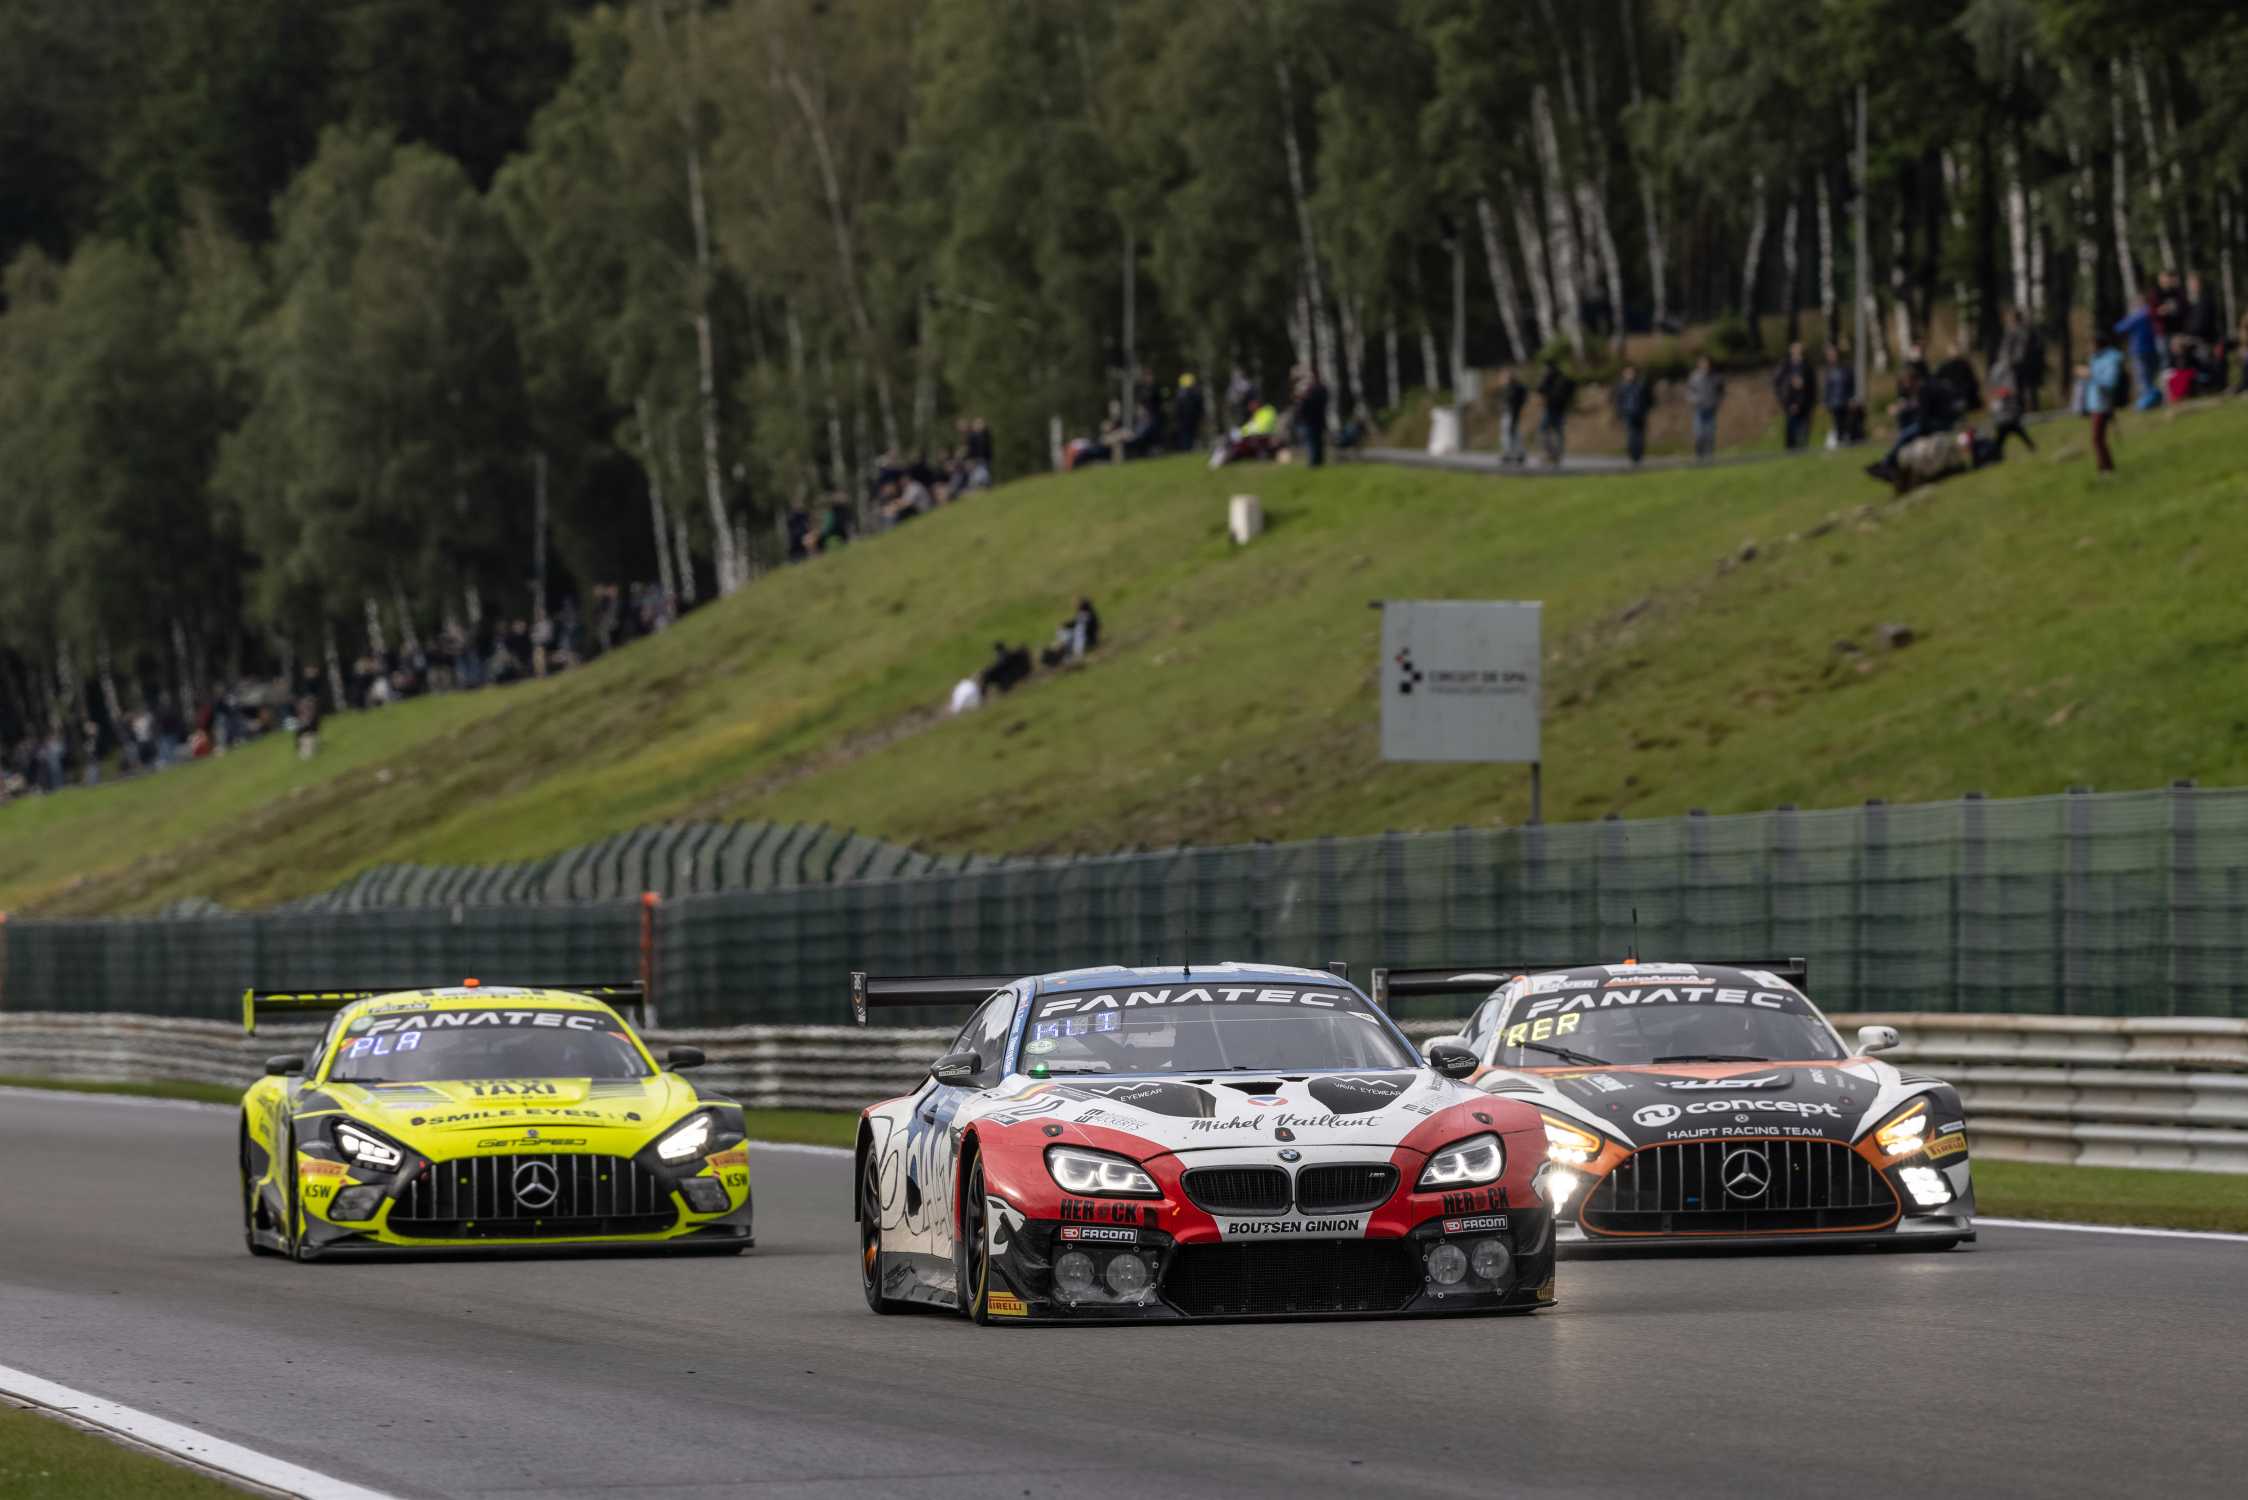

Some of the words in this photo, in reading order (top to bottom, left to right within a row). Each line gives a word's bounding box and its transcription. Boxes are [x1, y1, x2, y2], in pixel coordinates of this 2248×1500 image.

[1039, 988, 1343, 1018] FANATEC
[1526, 987, 1786, 1019] FANATEC
[366, 1011, 596, 1037] FANATEC
[349, 1031, 422, 1059] PLA
[1120, 1087, 1163, 1103] EYEWEAR
[428, 1108, 515, 1125] SMILE
[526, 1108, 601, 1118] EYES
[1686, 1099, 1842, 1118] concept
[1190, 1114, 1264, 1132] Michel
[1272, 1113, 1384, 1129] Vaillant
[1667, 1128, 1713, 1139] HAUPT
[1716, 1126, 1779, 1137] RACING
[1783, 1126, 1824, 1137] TEAM
[304, 1184, 332, 1199] KSW
[1228, 1222, 1301, 1235] BOUTSEN
[1305, 1220, 1360, 1232] GINION
[1463, 1217, 1506, 1230] FACOM
[1082, 1229, 1135, 1241] FACOM
